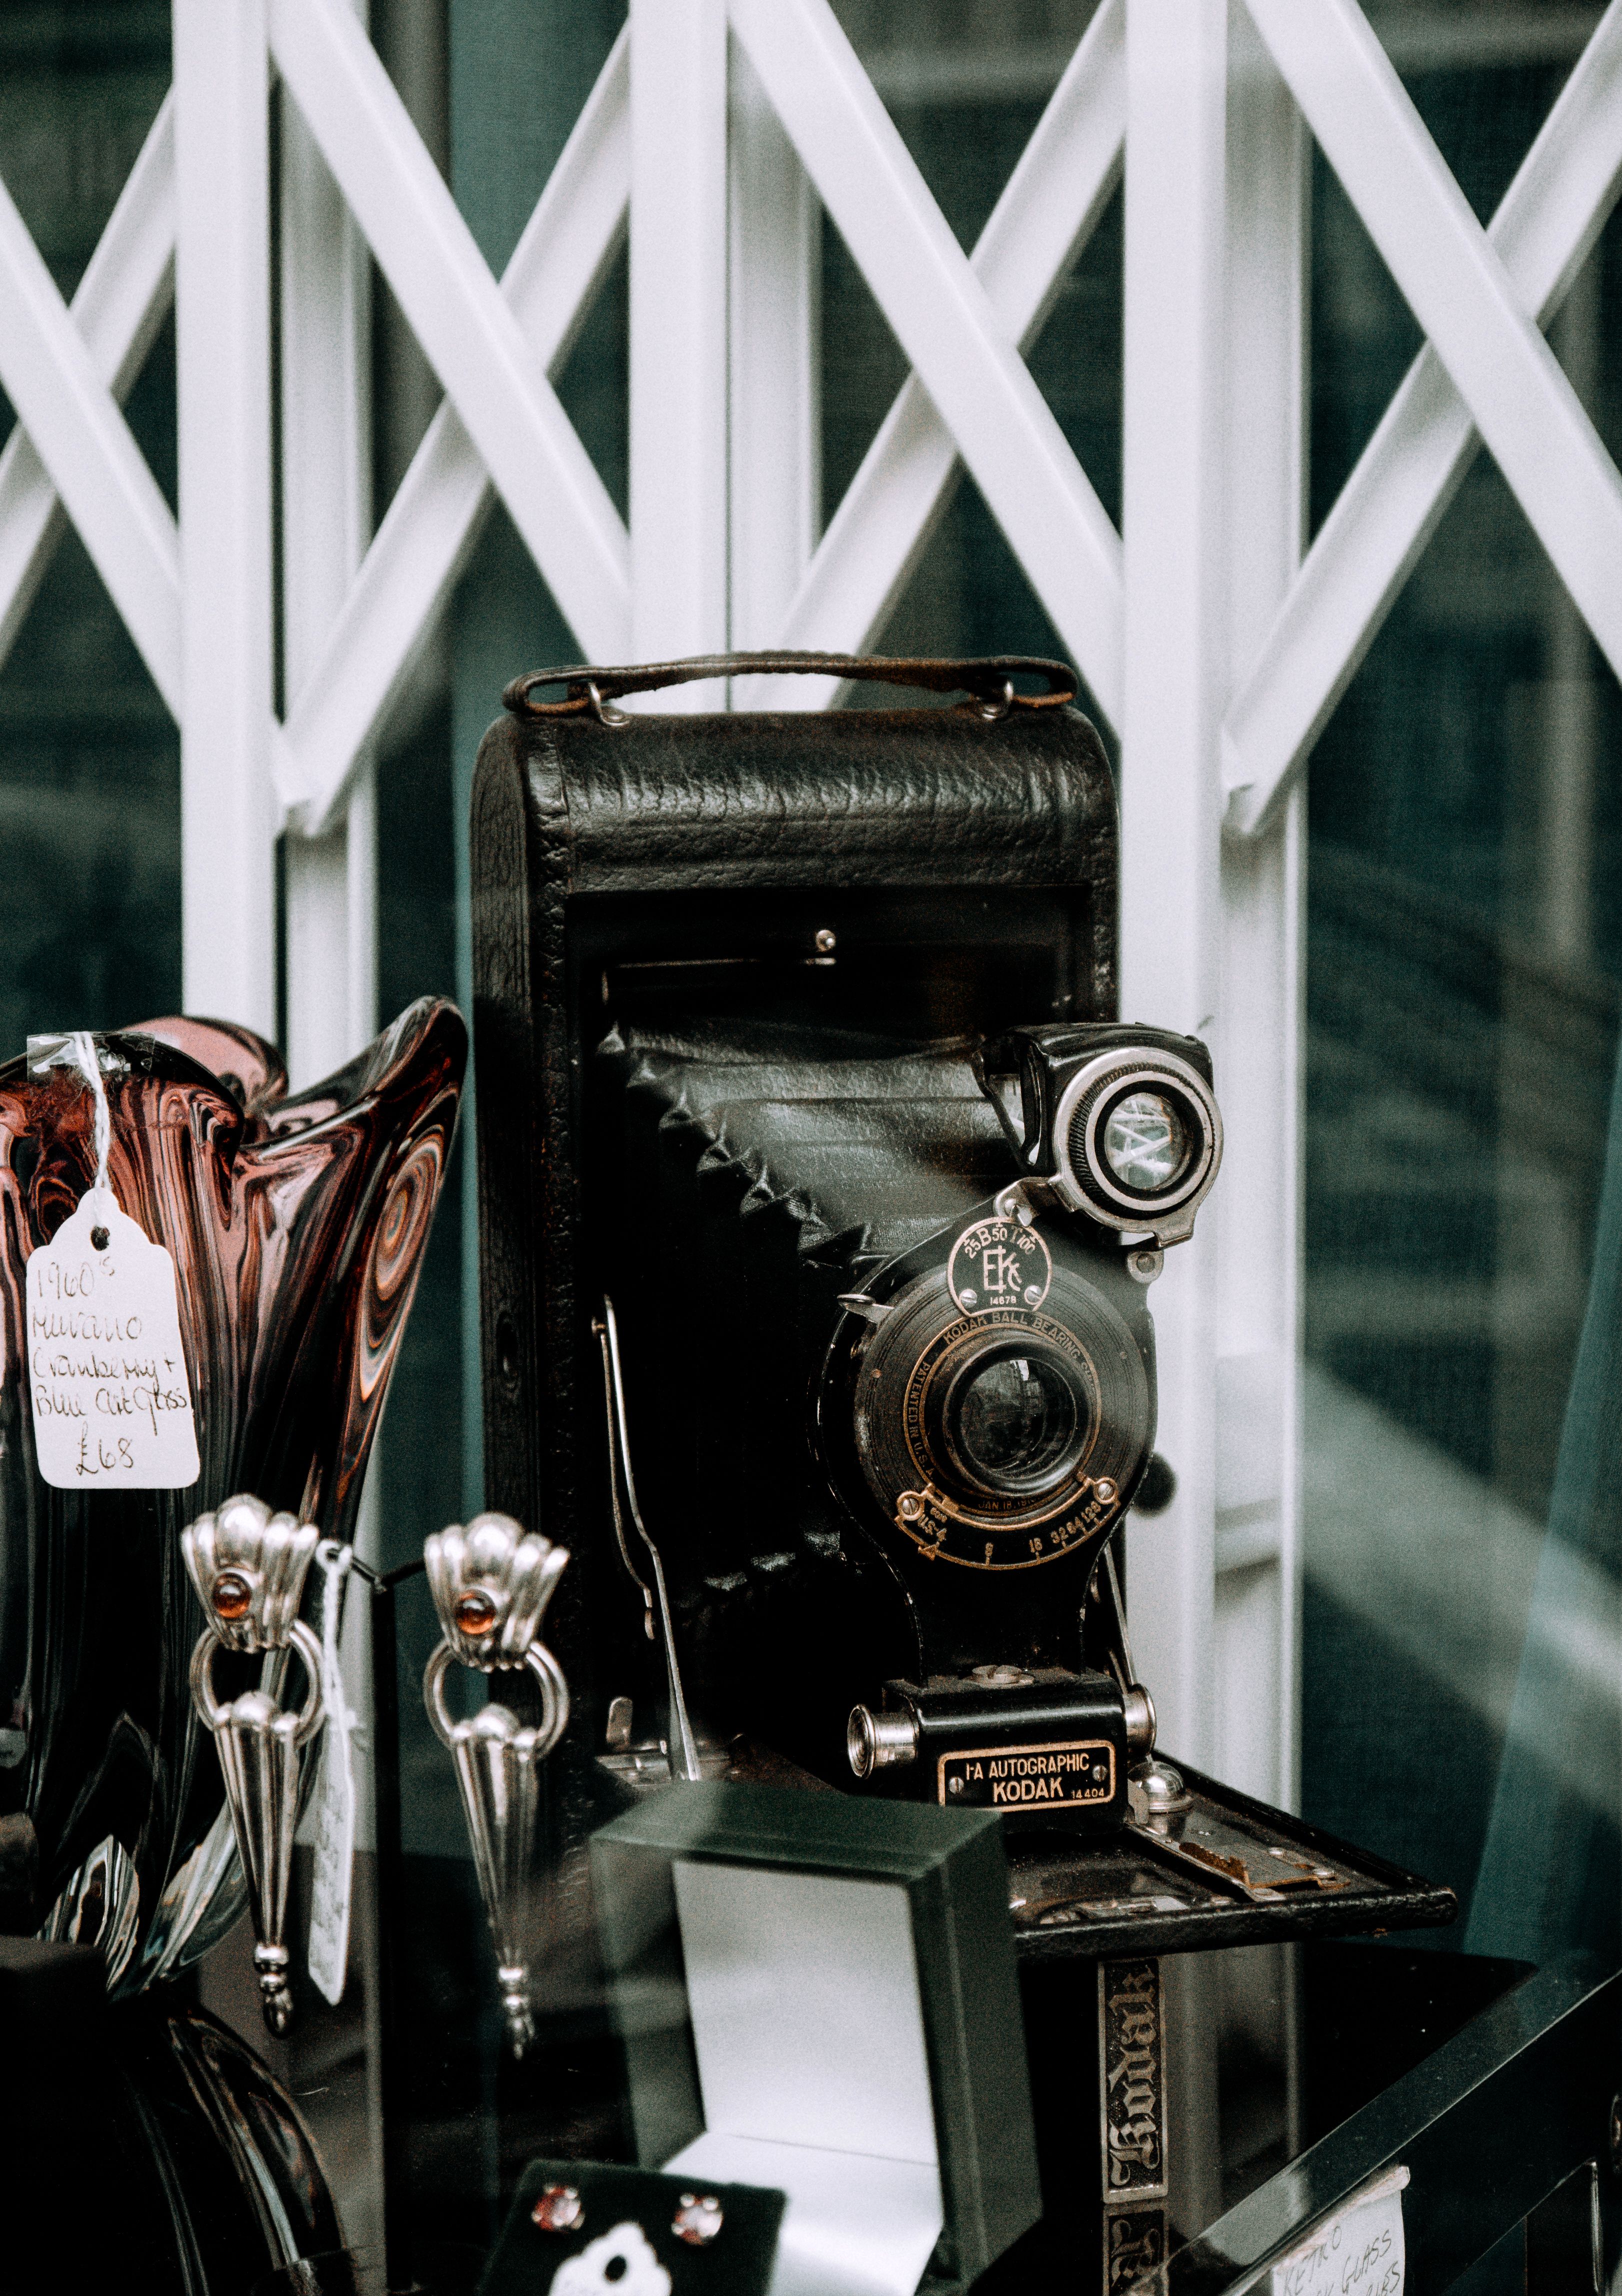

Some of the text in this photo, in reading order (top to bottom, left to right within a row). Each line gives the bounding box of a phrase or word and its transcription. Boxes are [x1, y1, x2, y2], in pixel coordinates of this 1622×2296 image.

[964, 1226, 1036, 1259] 25 B 50 T 100
[38, 1256, 114, 1300] 1960's
[943, 1312, 1080, 1360] KODAK BALL BEARING
[36, 1384, 88, 1417] Blue
[908, 1360, 931, 1422] PATENTED
[76, 1420, 134, 1476] £68
[908, 1426, 919, 1439] IN
[1029, 1537, 1043, 1553] 16
[1050, 1526, 1069, 1544] 32
[1066, 1516, 1084, 1534] 64
[989, 1754, 1090, 1778] AUTOGRAPHIC
[993, 1778, 1104, 1803] KODAK 14404
[1108, 1964, 1160, 2186] Kodak
